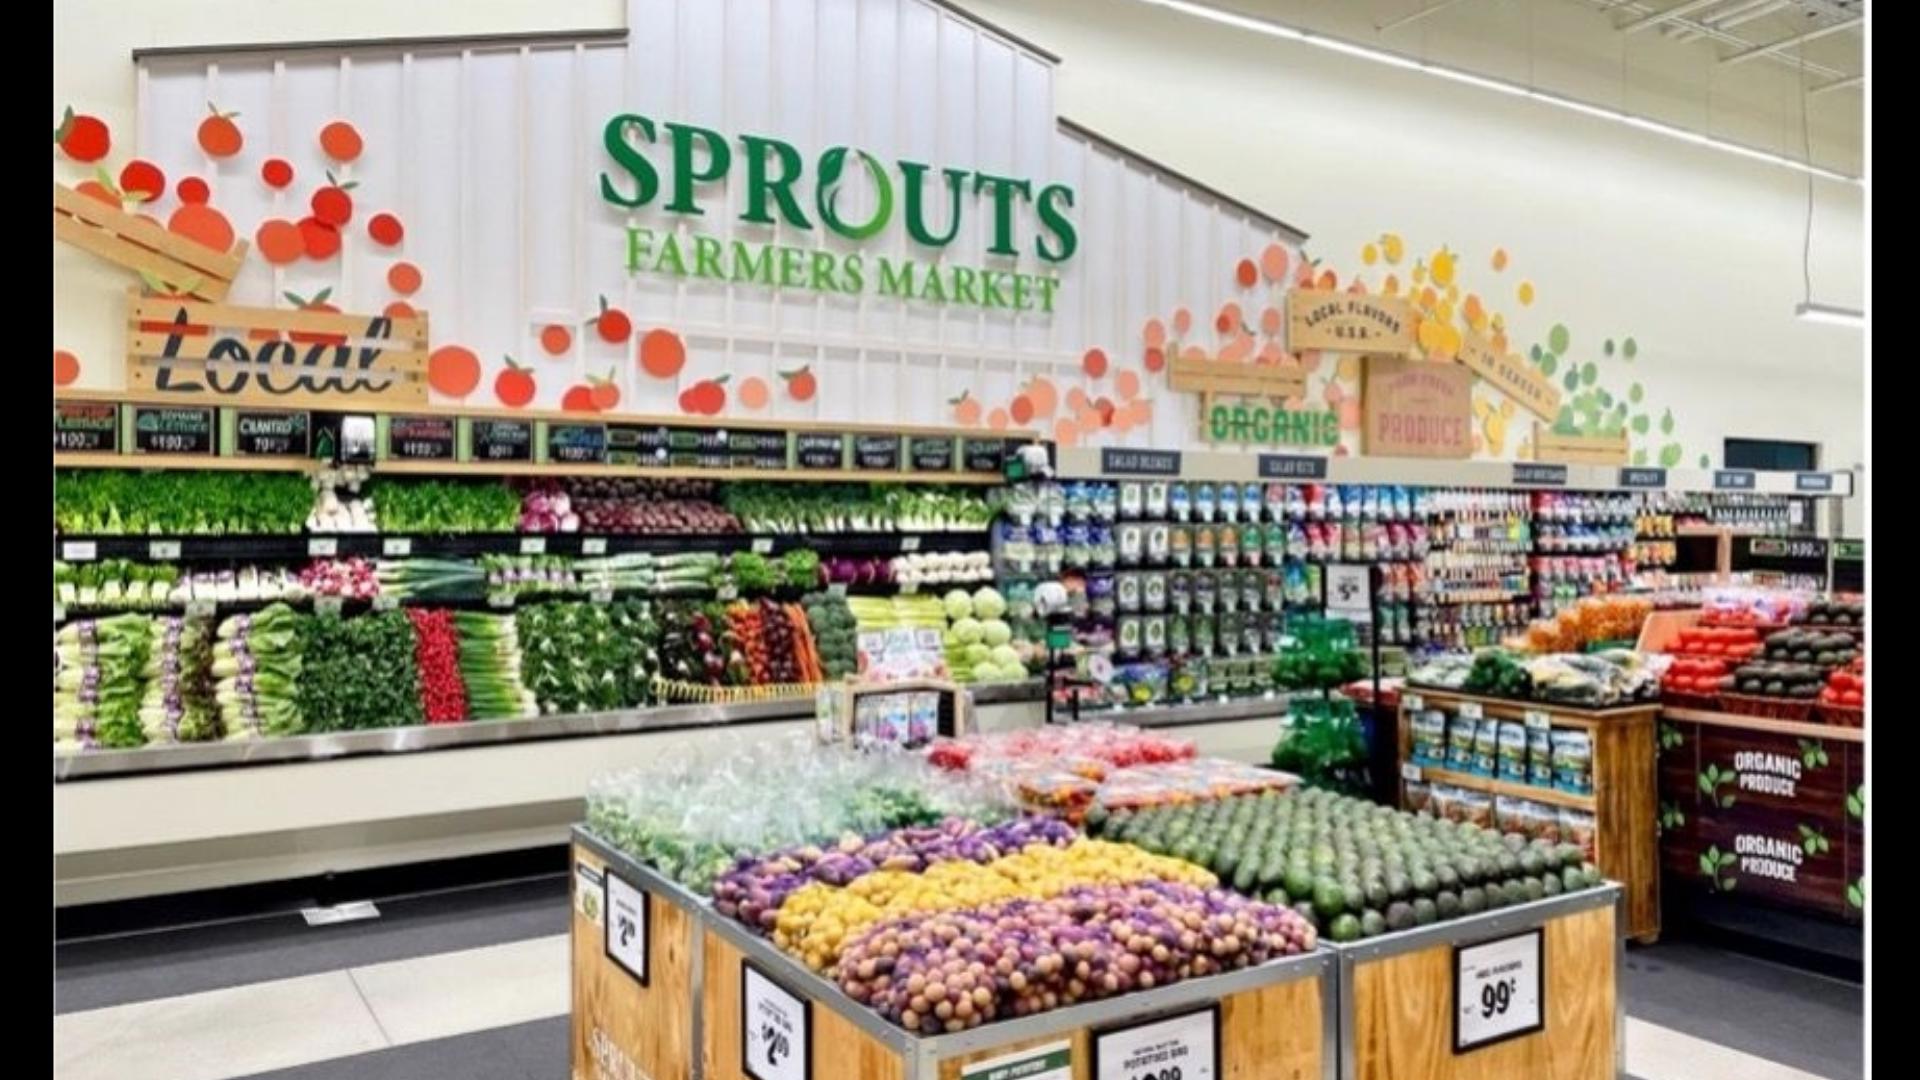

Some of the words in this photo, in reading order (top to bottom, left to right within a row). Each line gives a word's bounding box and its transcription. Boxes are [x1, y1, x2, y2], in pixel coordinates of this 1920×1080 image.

[600, 113, 1079, 263] SPROUTS
[625, 227, 864, 293] FARMERS
[877, 258, 1061, 313] MARKET
[1305, 303, 1342, 327] LOCAL
[1348, 301, 1400, 334] FLAVORS
[155, 306, 394, 395] Local
[239, 418, 293, 434] CILANTRO
[1211, 404, 1340, 446] ORGANIC
[1377, 412, 1463, 446] PRODUCE
[1734, 751, 1801, 780] ORGANIC
[1740, 773, 1795, 798] PRODUCE
[1735, 834, 1803, 865] ORGANIC
[1741, 856, 1796, 883] PRODUCE
